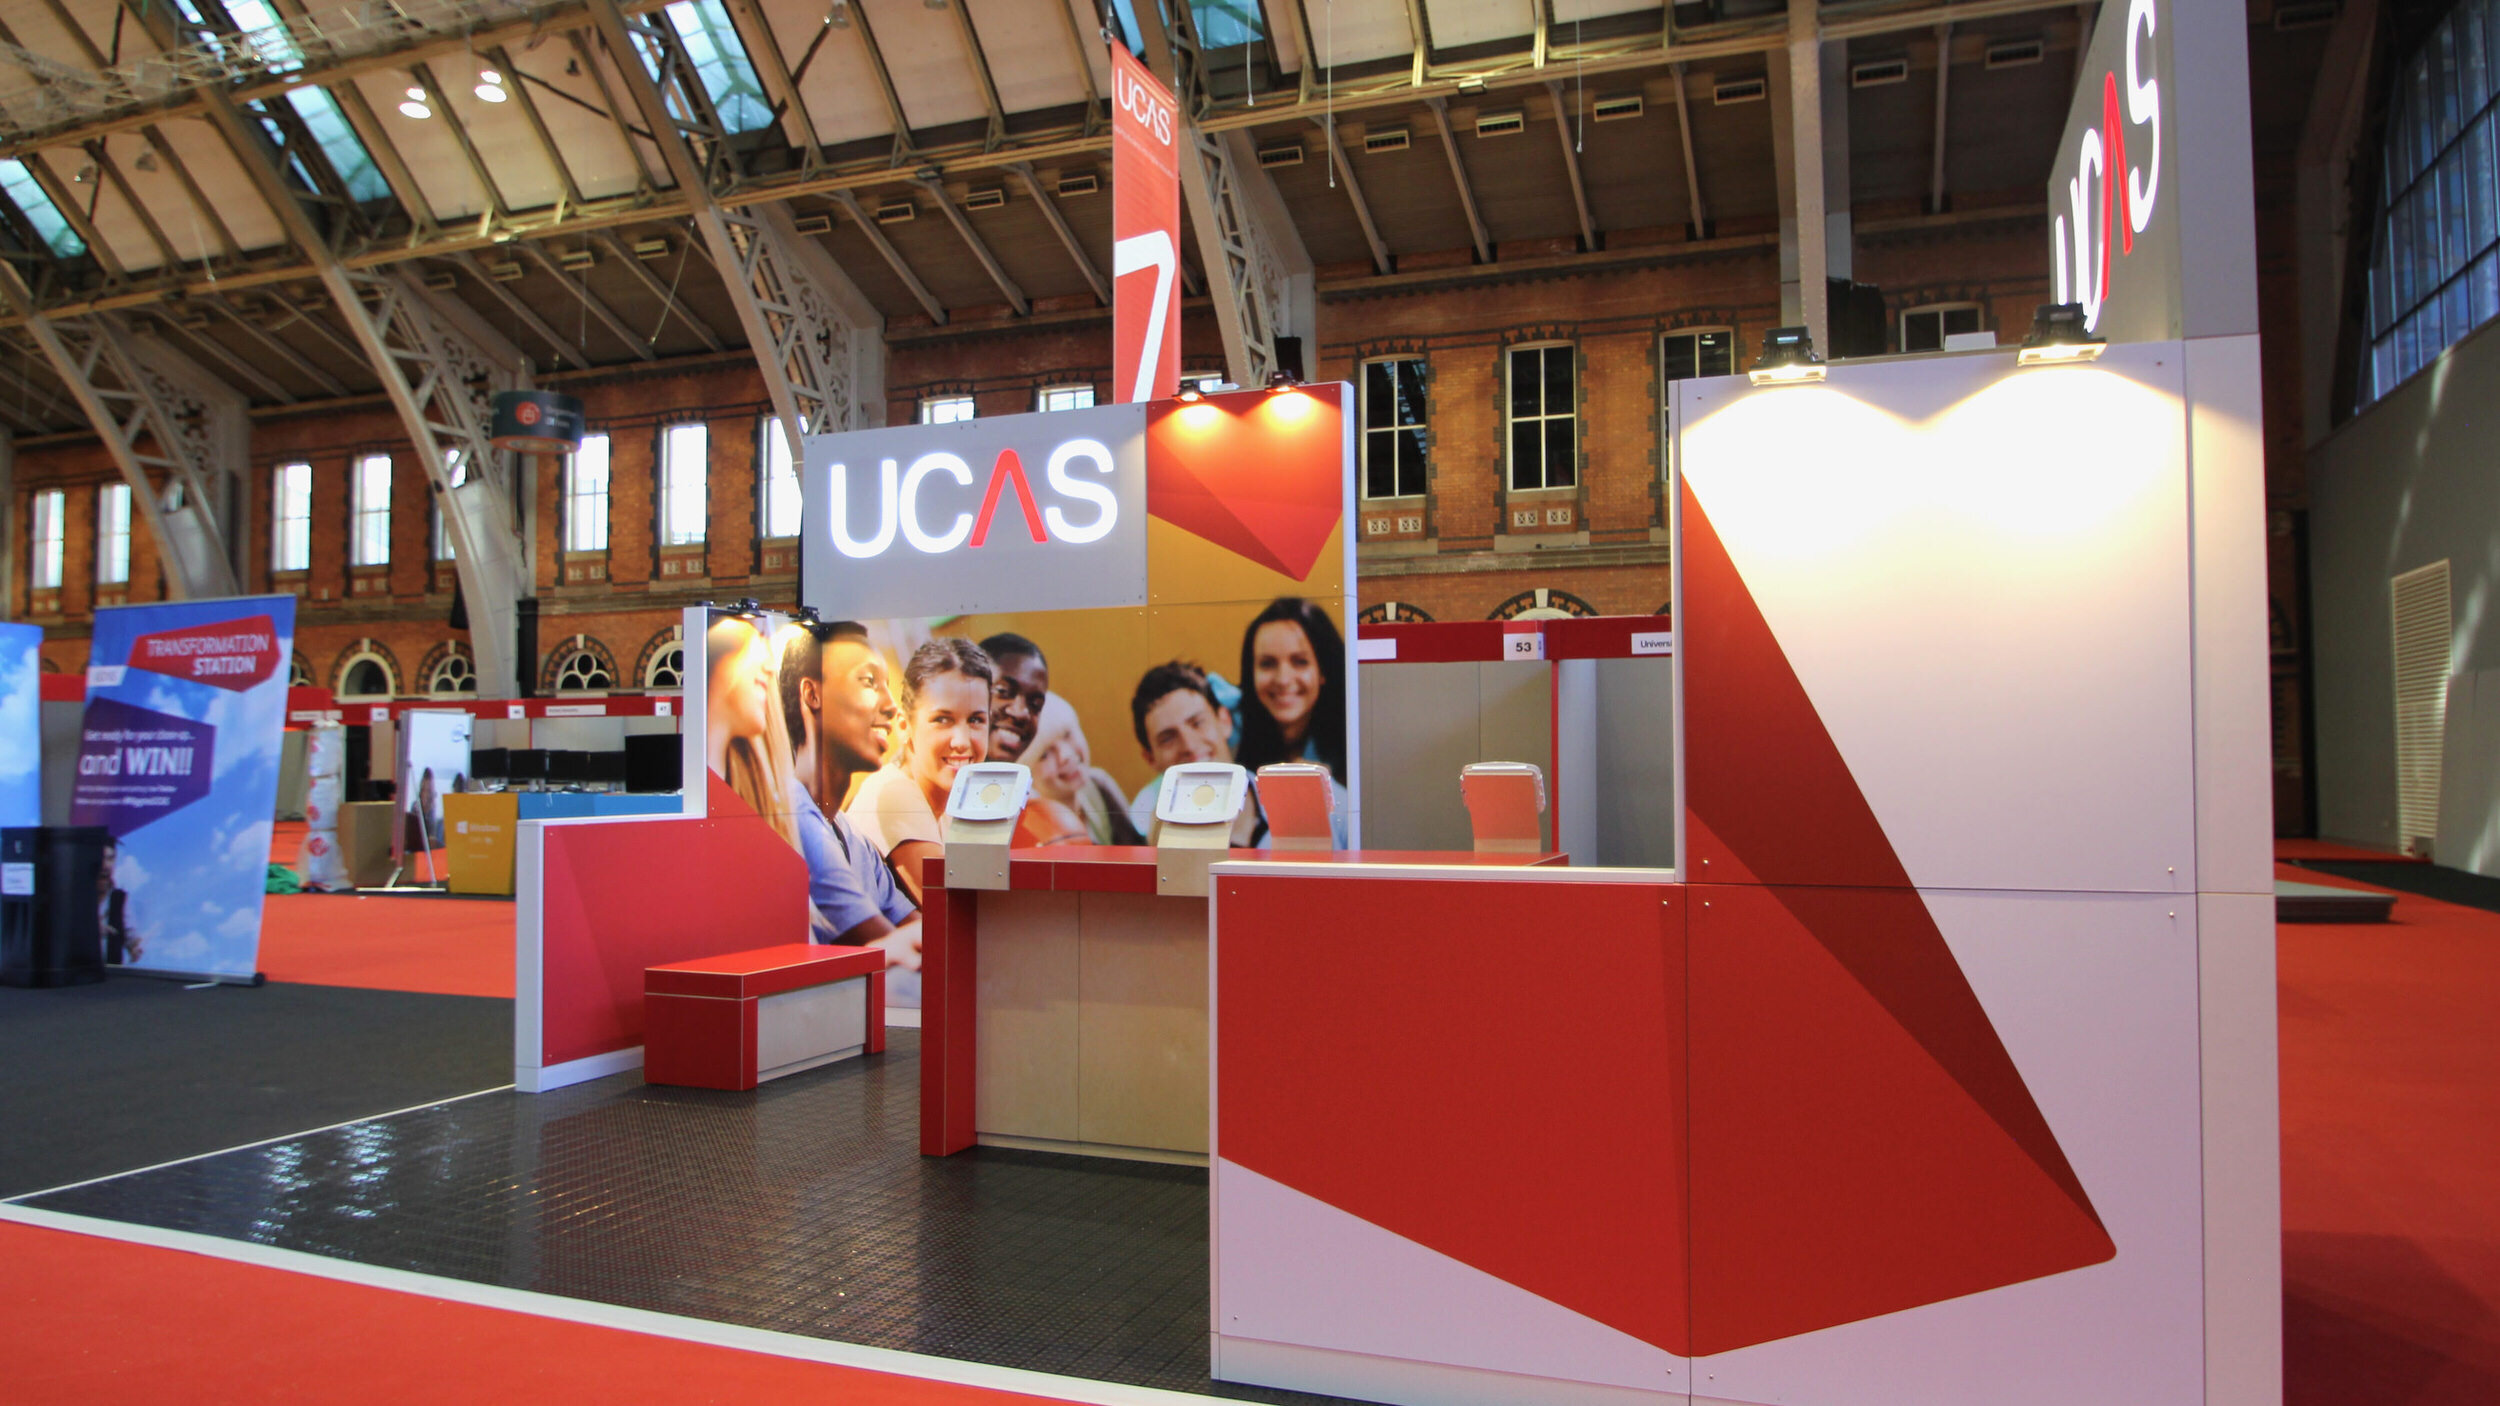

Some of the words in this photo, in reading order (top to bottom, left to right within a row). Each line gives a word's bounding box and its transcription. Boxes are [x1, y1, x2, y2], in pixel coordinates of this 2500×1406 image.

[1118, 67, 1171, 146] UCAS
[1115, 229, 1176, 403] 7
[829, 437, 1119, 559] UCAS
[148, 634, 269, 656] TRANSFORMATION
[1516, 641, 1532, 652] 53
[1640, 639, 1673, 648] Universi
[194, 657, 256, 676] STATION
[80, 747, 122, 775] and
